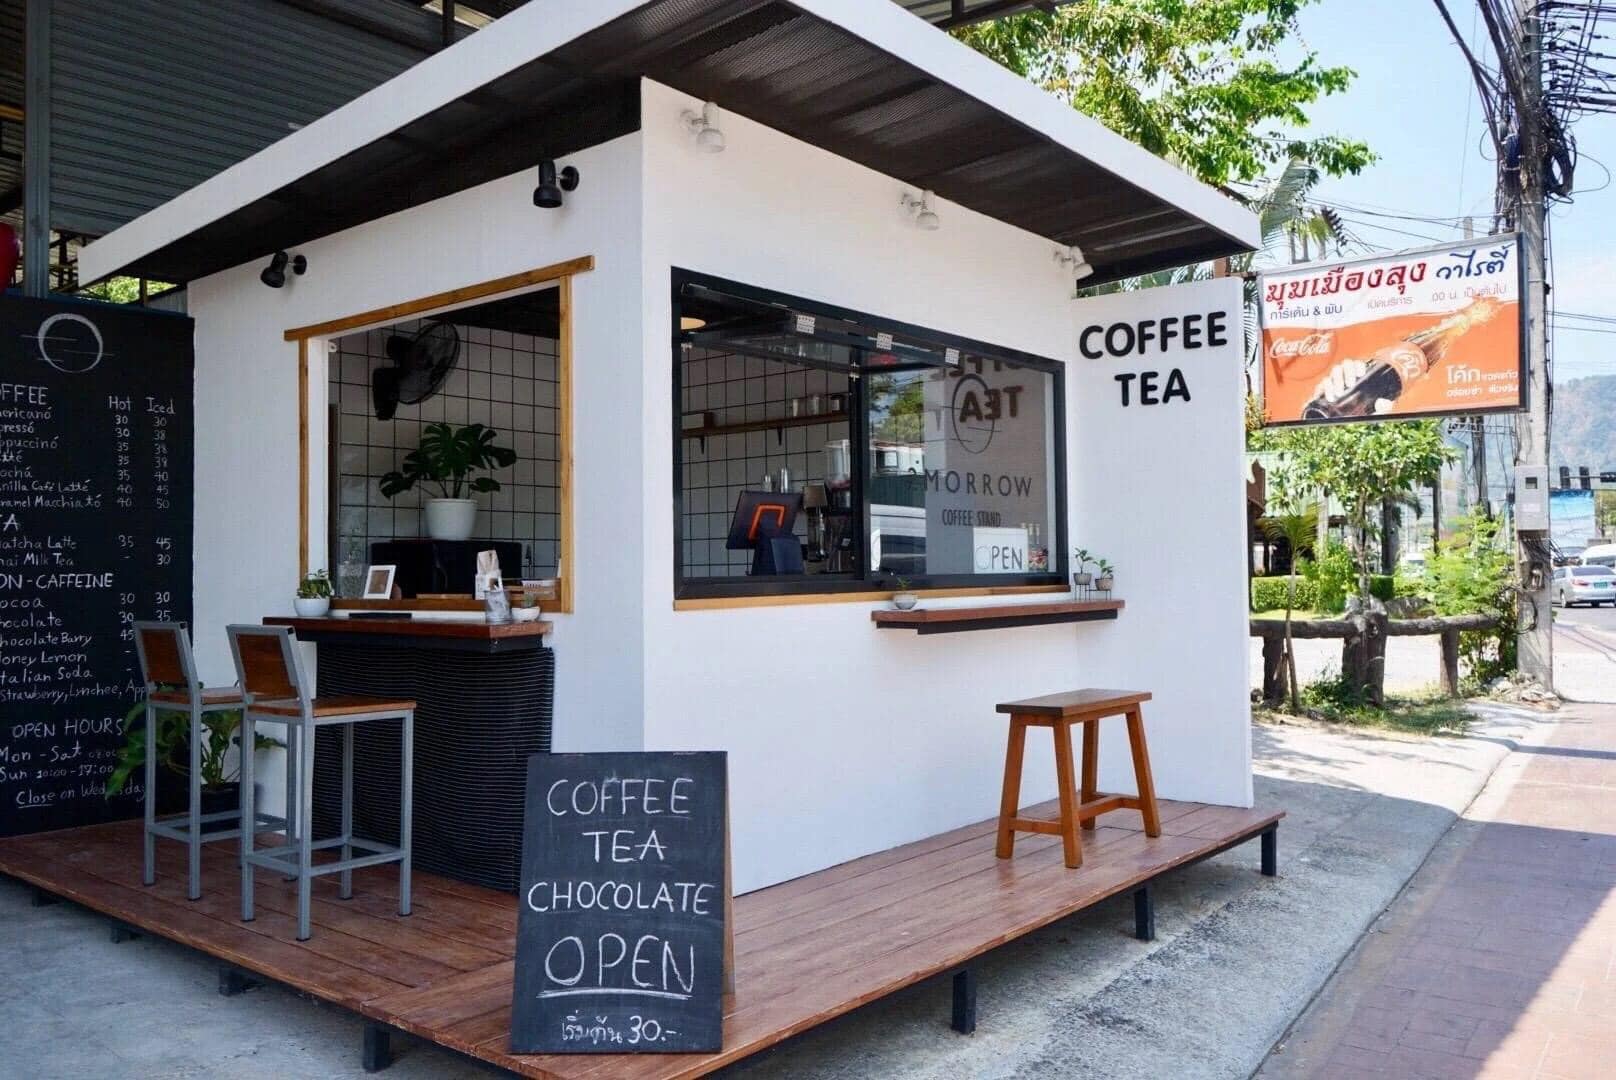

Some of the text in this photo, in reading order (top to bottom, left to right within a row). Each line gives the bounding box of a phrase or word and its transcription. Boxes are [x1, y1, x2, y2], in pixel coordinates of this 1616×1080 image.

[1313, 305, 1321, 316] &
[1079, 311, 1227, 359] COFFEE
[0, 383, 49, 405] FFEE
[1114, 368, 1191, 407] TEA
[108, 395, 176, 415] Hot Iced
[115, 414, 129, 425] 30
[154, 416, 167, 427] 30
[115, 428, 130, 438] 30
[942, 508, 1001, 528] COFFEE STAND
[118, 534, 136, 548] 35
[156, 537, 172, 550] 45
[157, 554, 171, 565] 30
[974, 546, 1024, 571] OPEN
[119, 592, 135, 605] 30
[156, 591, 171, 603] 30
[119, 611, 134, 624] 30
[0, 651, 87, 667] oney Lemon
[57, 665, 93, 680] Soda
[12, 717, 125, 739] OPEN HOURS
[0, 766, 28, 782] Sun
[16, 788, 57, 806] Close
[60, 788, 76, 800] on
[547, 777, 693, 816] COFFEE
[582, 830, 667, 863] TEA
[527, 881, 715, 915] CHOCOLATE
[545, 933, 695, 993] OPEN
